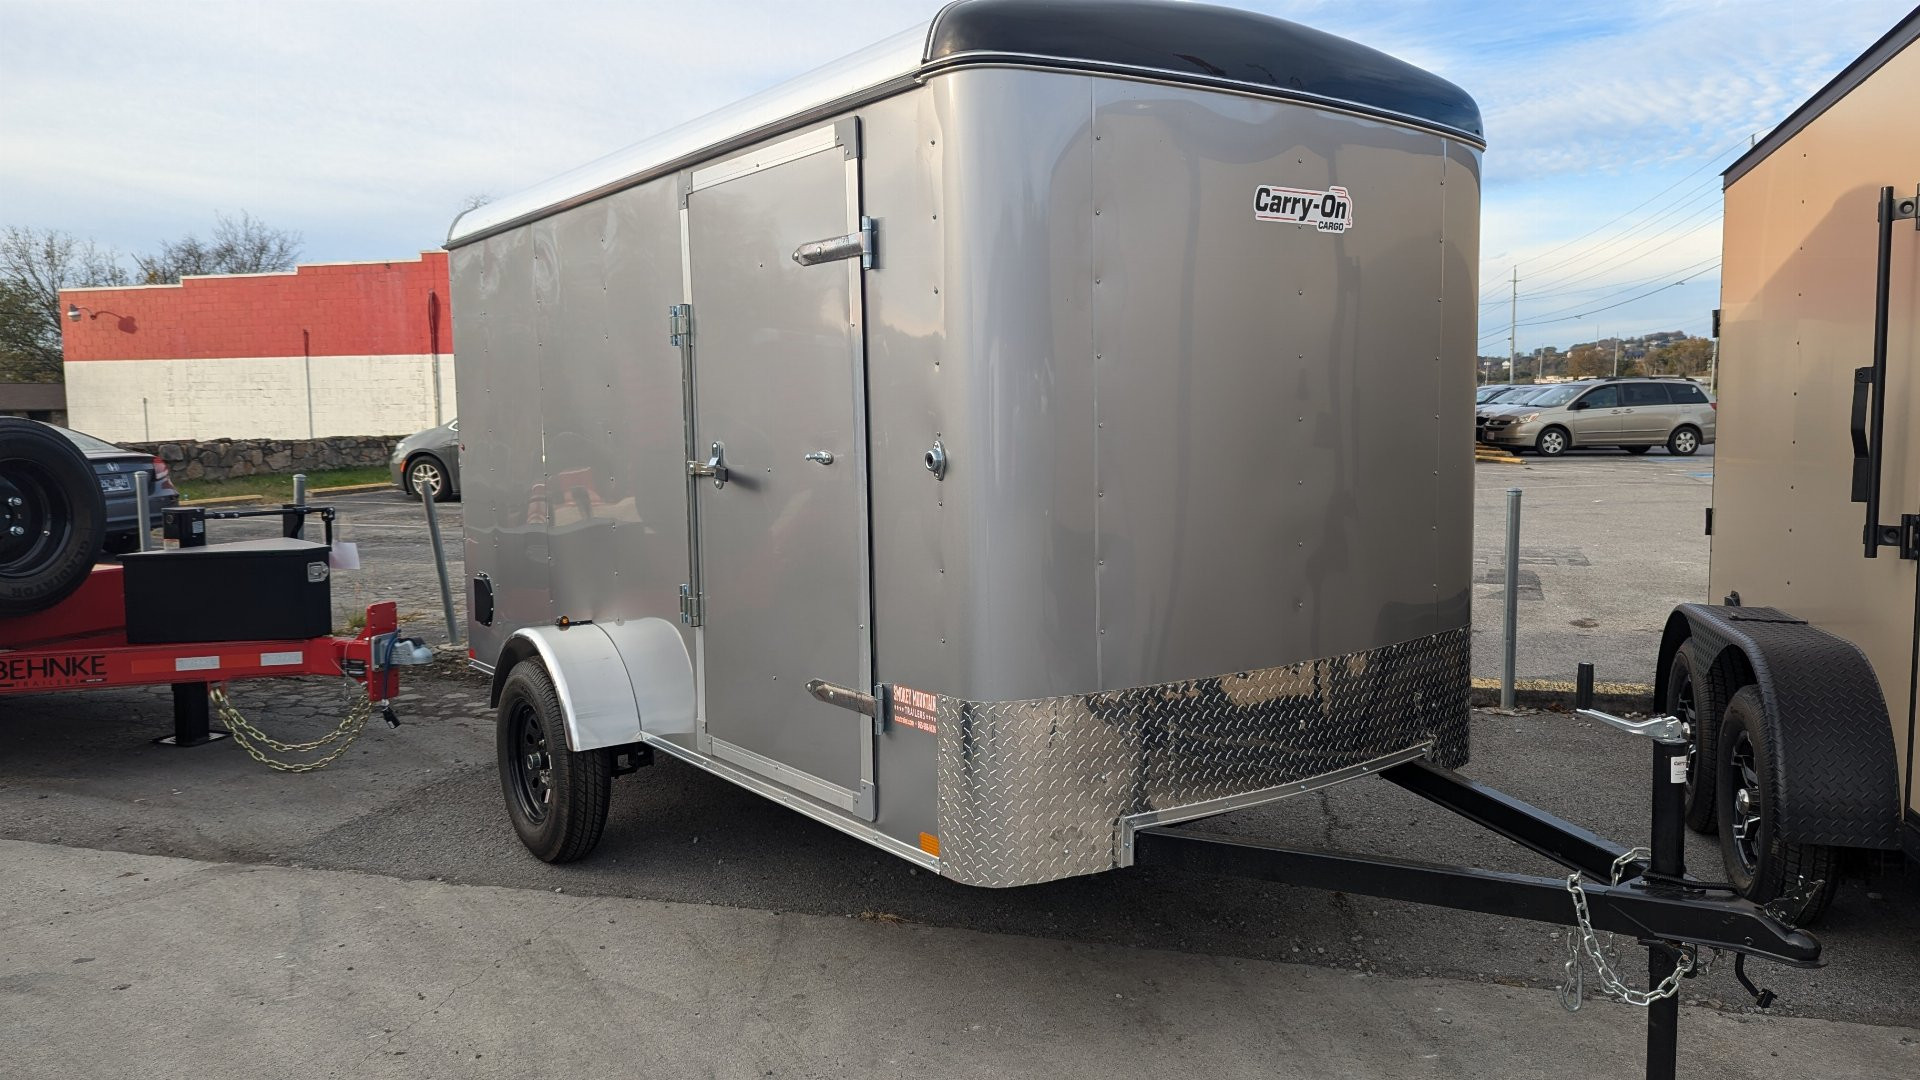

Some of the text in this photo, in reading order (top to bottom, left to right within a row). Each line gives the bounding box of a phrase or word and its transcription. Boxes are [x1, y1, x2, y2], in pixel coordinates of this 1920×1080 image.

[1255, 188, 1347, 221] Carry-On
[1318, 221, 1344, 231] CARGO
[904, 706, 926, 720] TRAILERS
